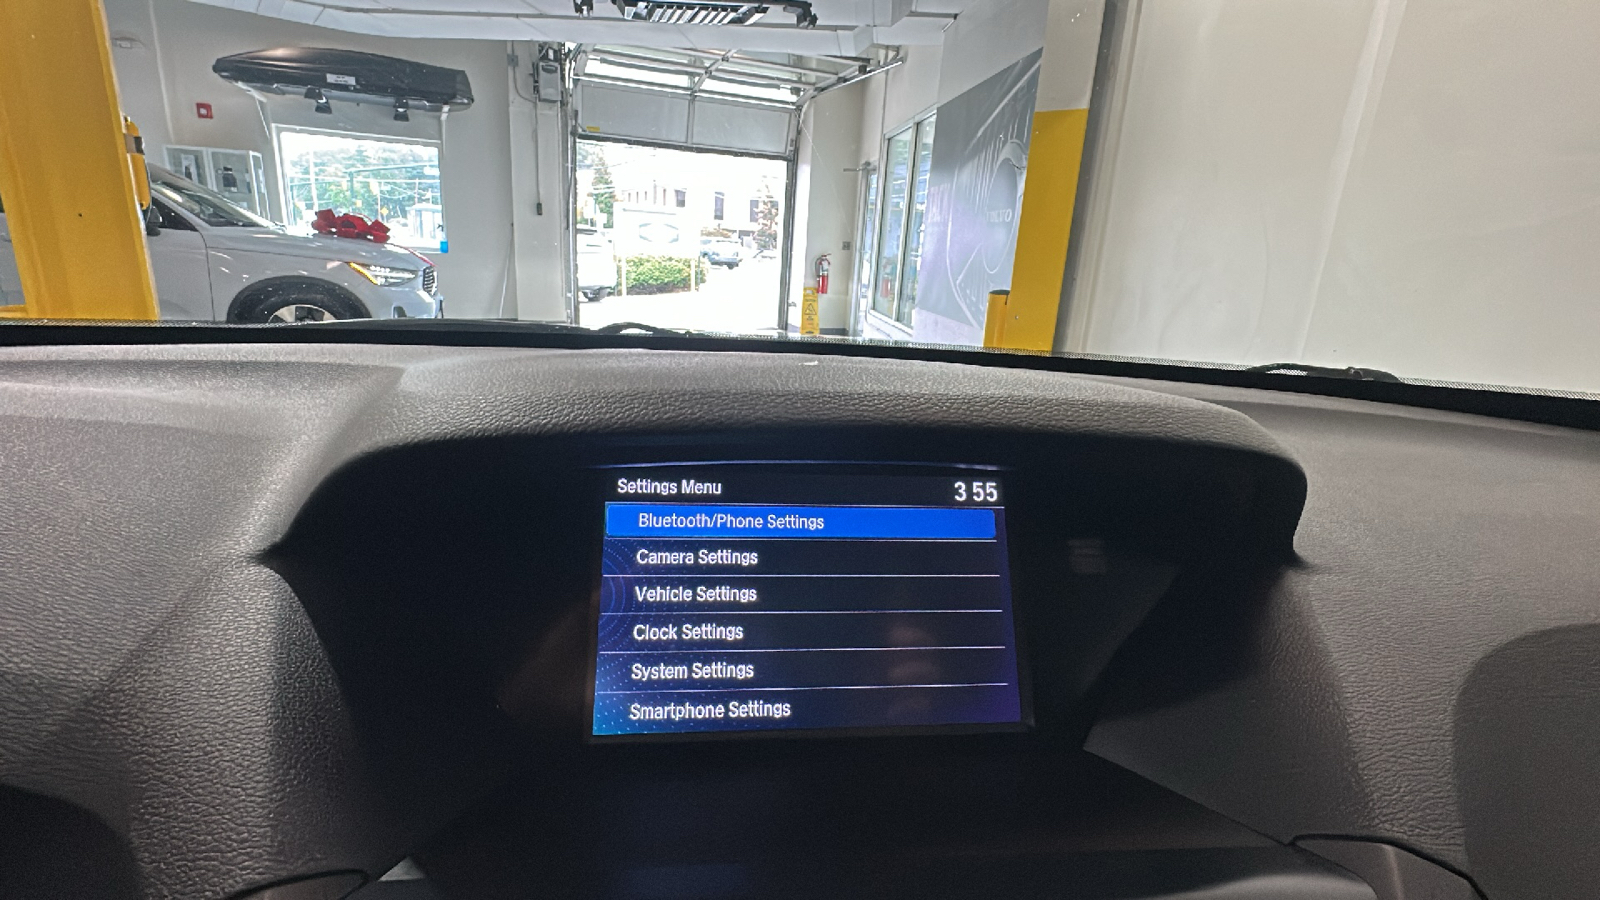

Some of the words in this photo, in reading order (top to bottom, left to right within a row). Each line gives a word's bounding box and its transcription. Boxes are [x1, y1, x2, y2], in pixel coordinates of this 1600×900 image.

[617, 478, 678, 496] Settings
[681, 479, 723, 495] Menu
[638, 512, 764, 529] Bluetooth/Phone
[766, 514, 825, 531] Settings
[636, 549, 694, 565] Camera
[697, 549, 759, 566] Settings
[635, 586, 693, 602] Vehicle
[696, 586, 758, 603] Settings
[632, 623, 678, 641] Clock
[681, 623, 744, 641] Settings
[631, 662, 688, 681] System
[691, 662, 755, 680] Settings
[629, 702, 725, 721] Smartphone
[728, 700, 792, 719] Settings
